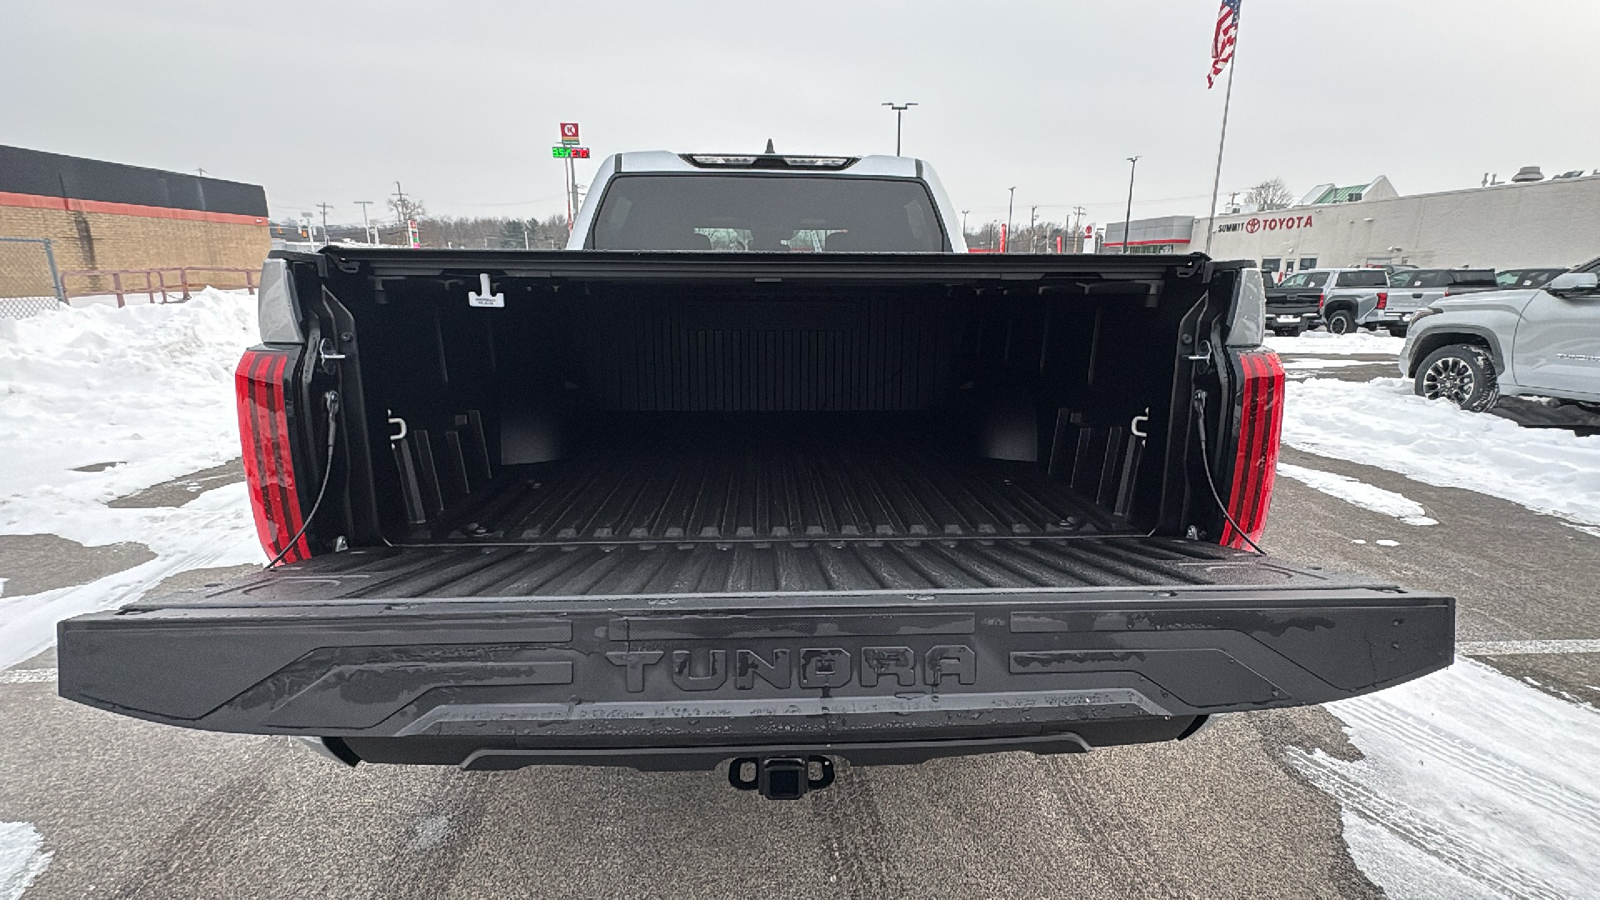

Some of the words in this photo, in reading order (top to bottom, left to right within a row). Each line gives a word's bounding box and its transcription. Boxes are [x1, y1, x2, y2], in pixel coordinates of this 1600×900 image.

[1218, 222, 1245, 233] SUMMIT
[1262, 215, 1313, 231] TOYOTA
[604, 644, 977, 693] TUNDRA
